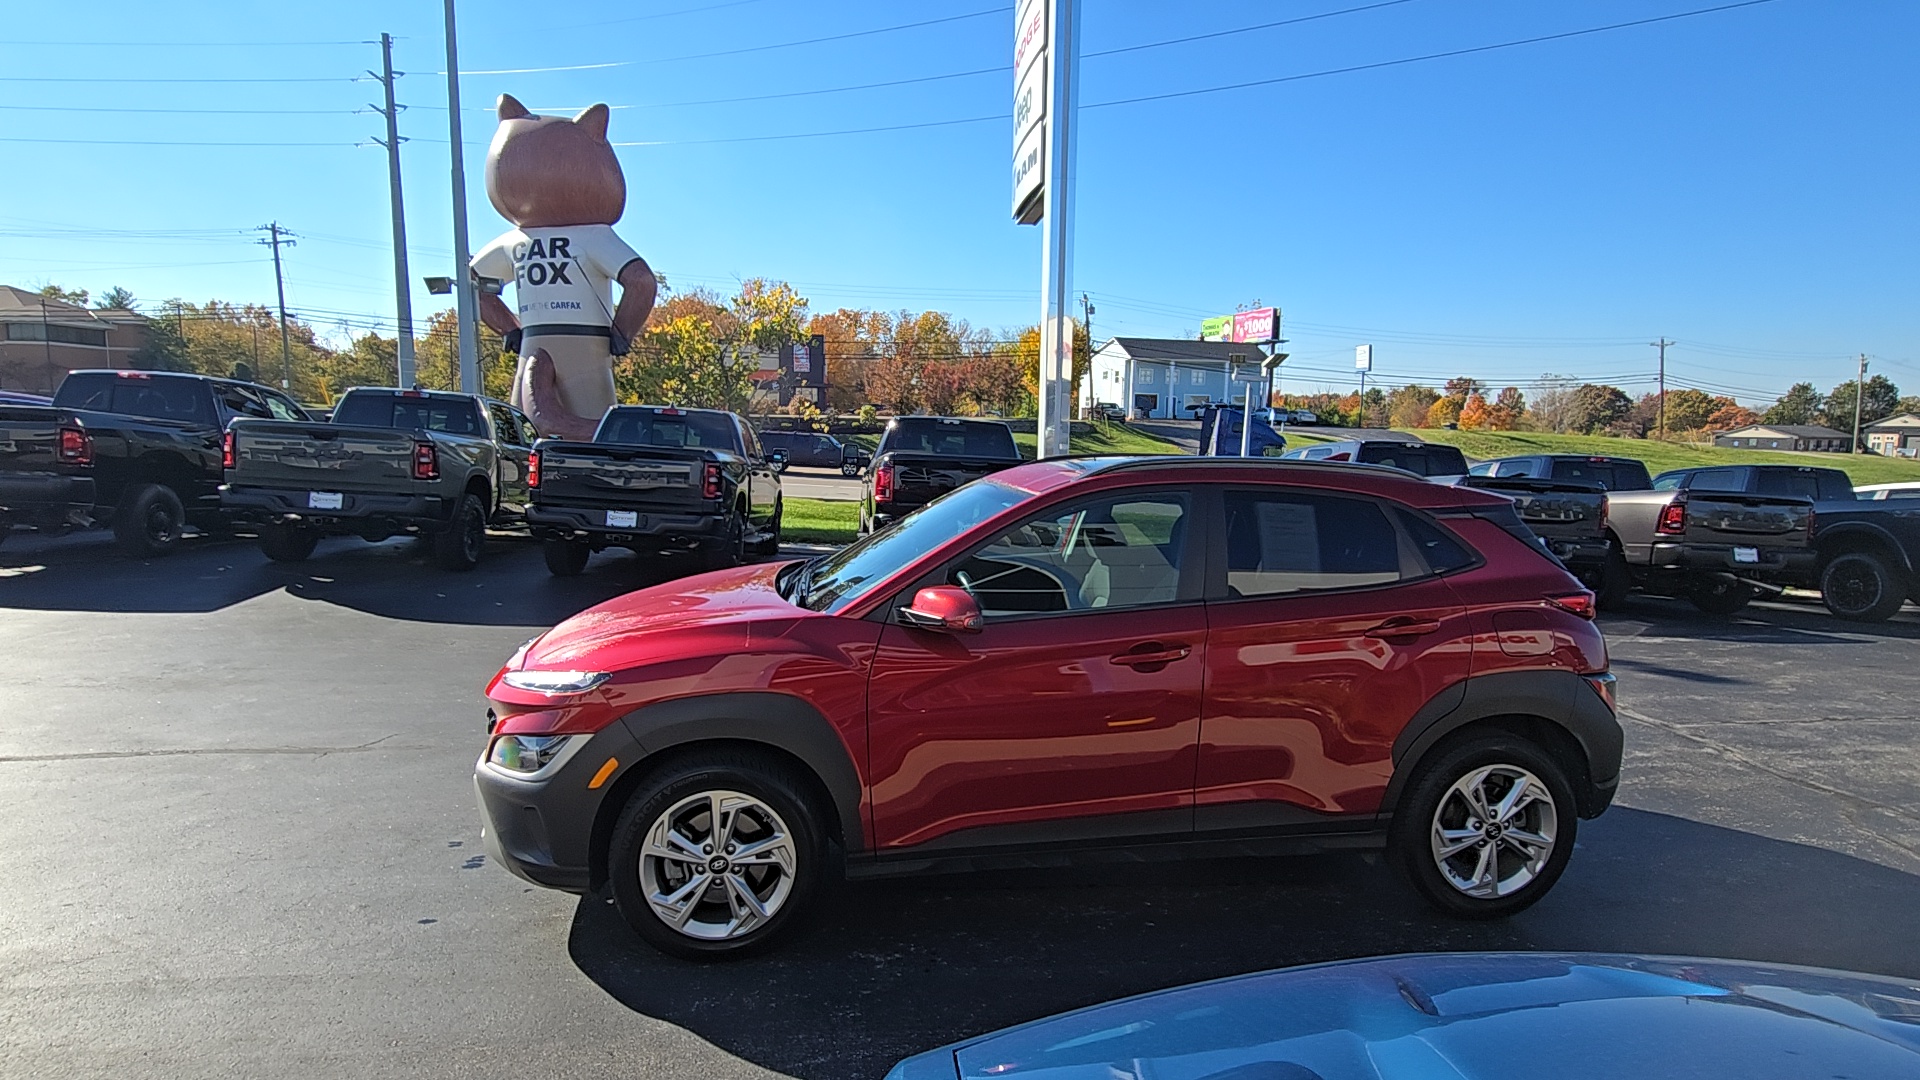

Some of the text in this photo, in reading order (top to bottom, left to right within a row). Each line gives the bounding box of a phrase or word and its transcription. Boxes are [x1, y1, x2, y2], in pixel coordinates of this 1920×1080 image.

[512, 237, 572, 263] CAR
[515, 261, 574, 290] FOX
[550, 301, 582, 310] CARFAX
